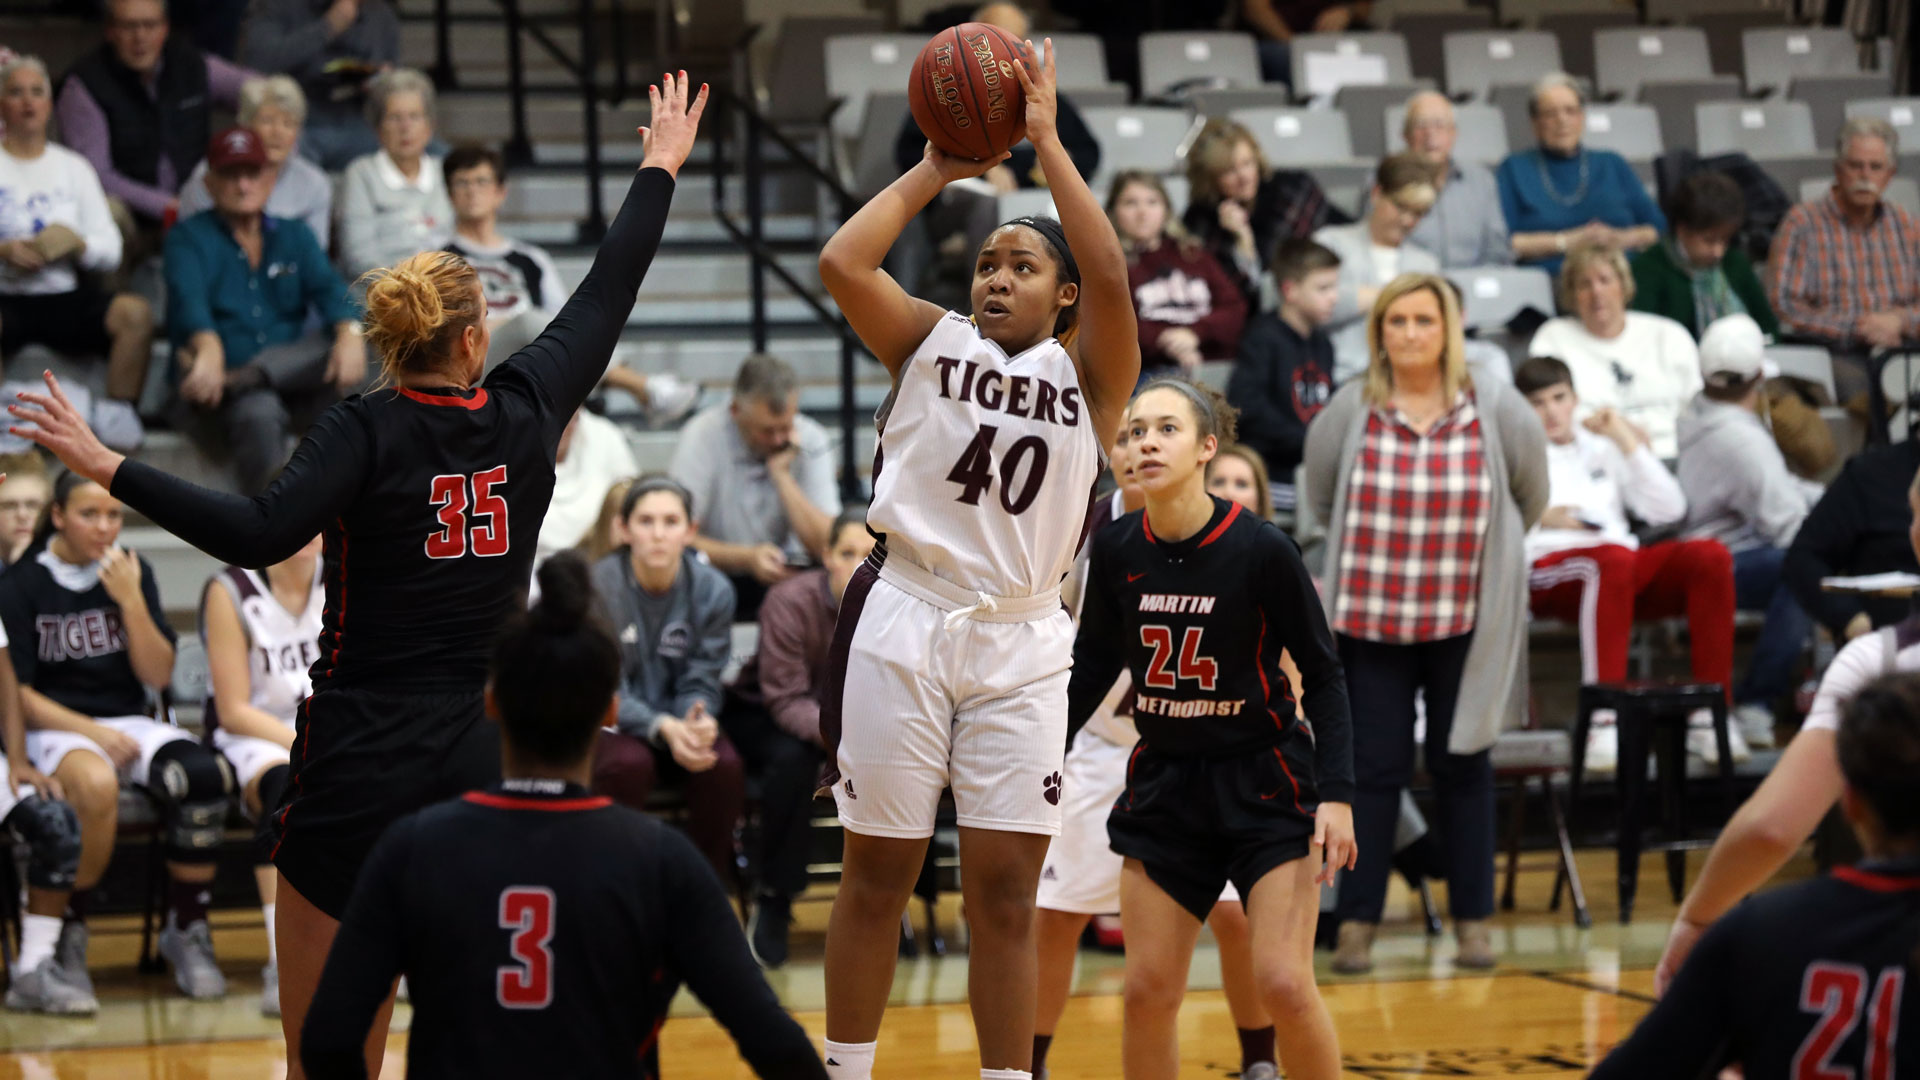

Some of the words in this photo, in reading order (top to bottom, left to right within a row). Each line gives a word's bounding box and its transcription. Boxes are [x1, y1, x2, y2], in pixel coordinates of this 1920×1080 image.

[935, 42, 972, 129] TF-1000
[964, 33, 1008, 123] SPALDING
[934, 355, 1079, 427] TIGERS
[424, 464, 510, 559] 35
[945, 423, 1049, 516] 40
[36, 608, 129, 662] TIGER
[1138, 593, 1217, 614] MARTIN
[1140, 624, 1218, 691] 24
[497, 885, 557, 1009] 3
[1790, 960, 1906, 1080] 21
